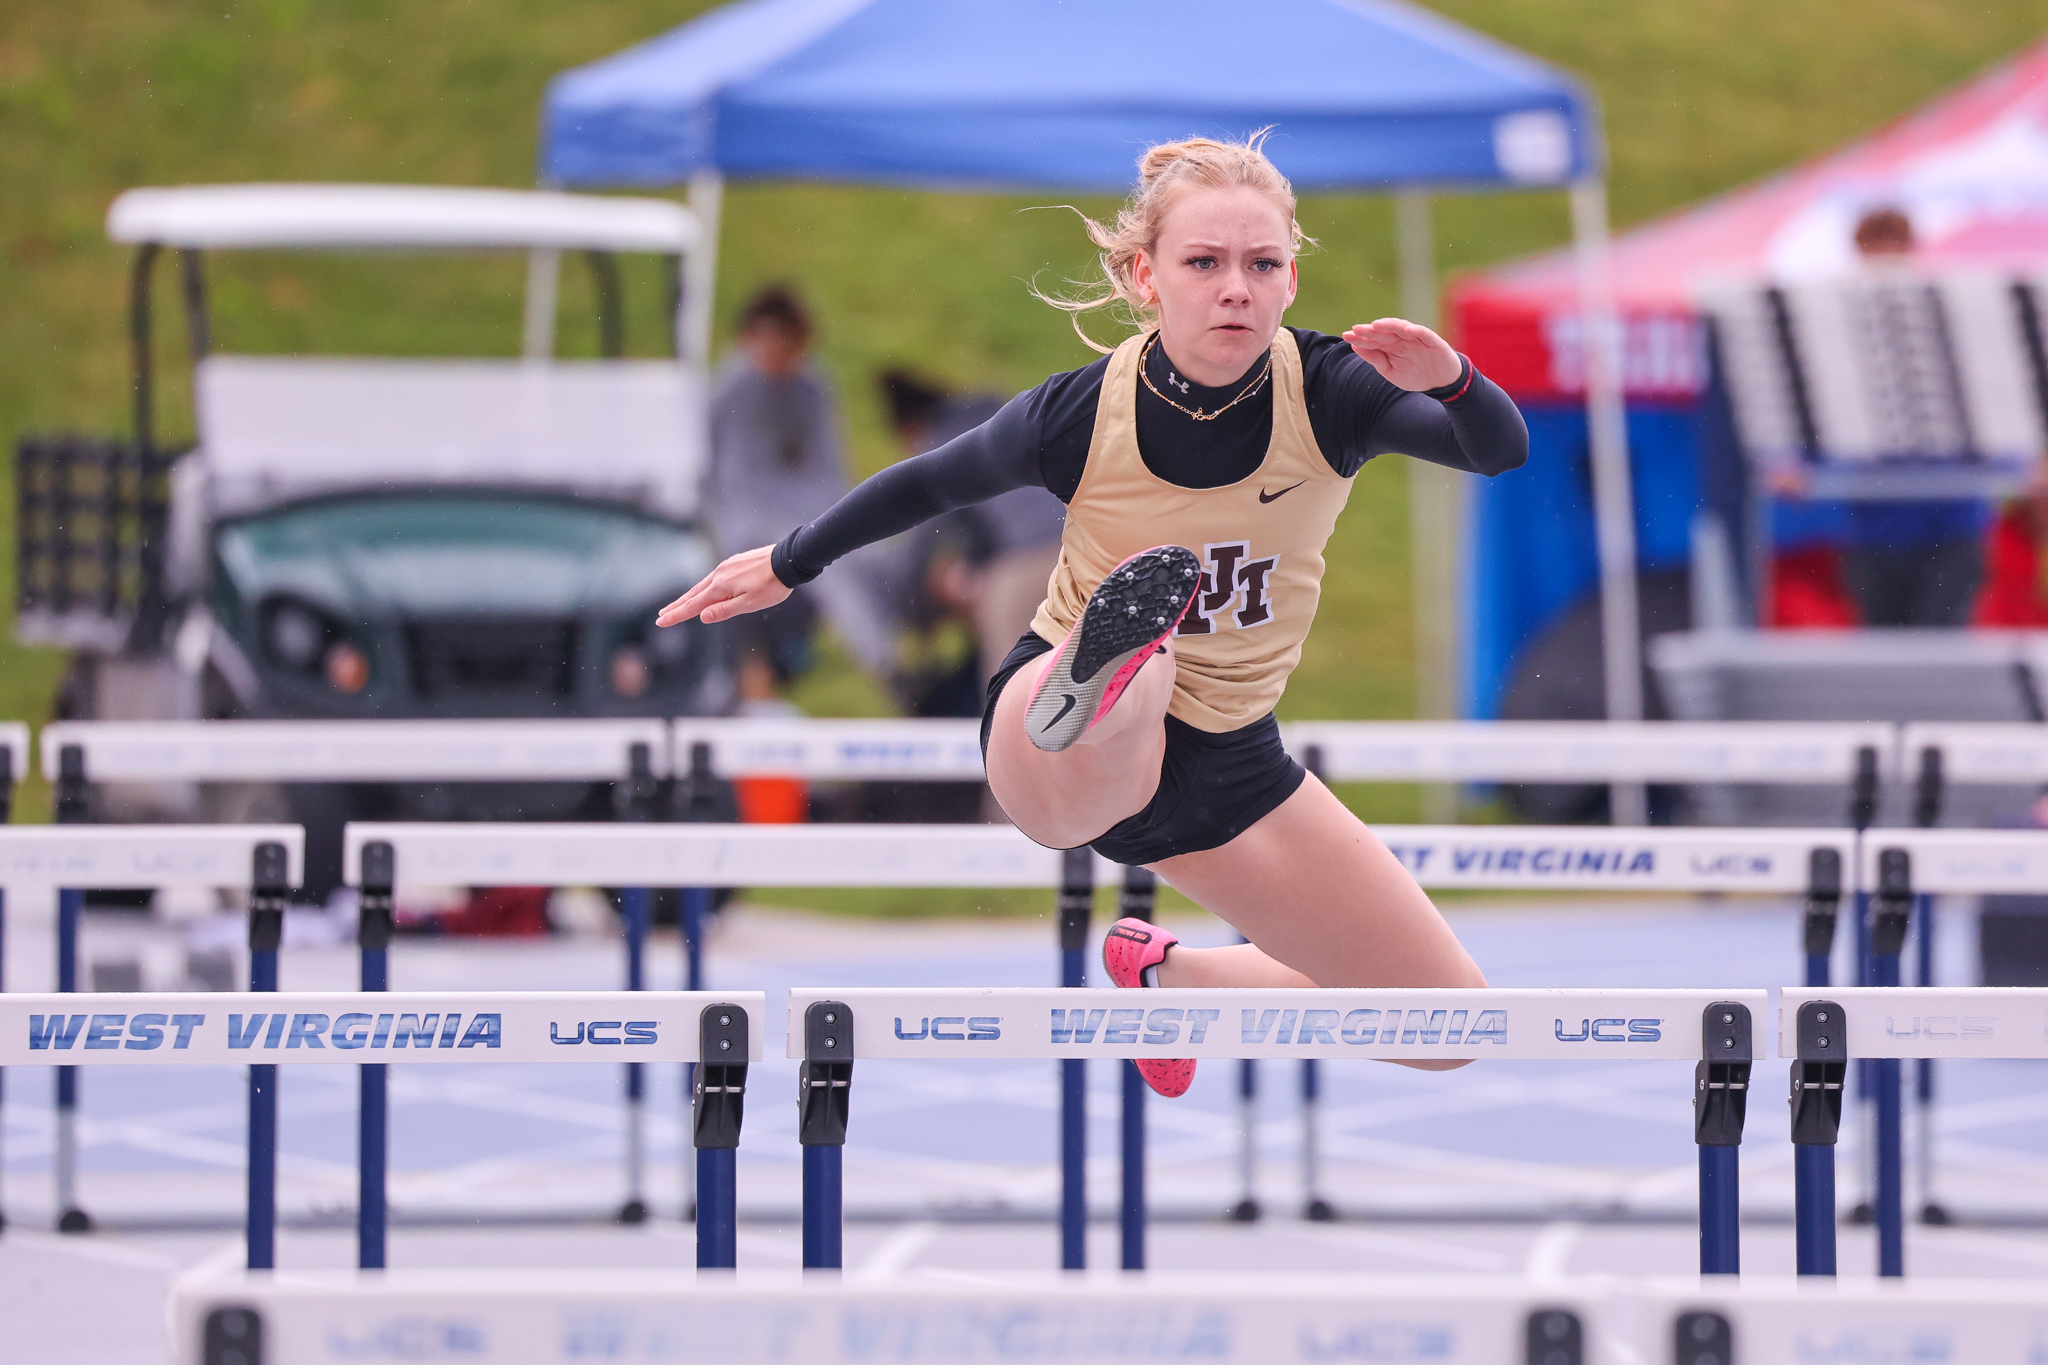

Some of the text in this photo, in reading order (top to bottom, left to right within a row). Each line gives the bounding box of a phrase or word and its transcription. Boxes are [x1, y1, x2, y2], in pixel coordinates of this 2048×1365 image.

[1453, 848, 1656, 874] VIRGINIA
[1690, 853, 1773, 877] UCS
[29, 1012, 658, 1051] WEST VIRGINIA UCS
[894, 1007, 1662, 1045] UCS WEST VIRGINIA UCS
[1886, 1016, 1995, 1040] UCS
